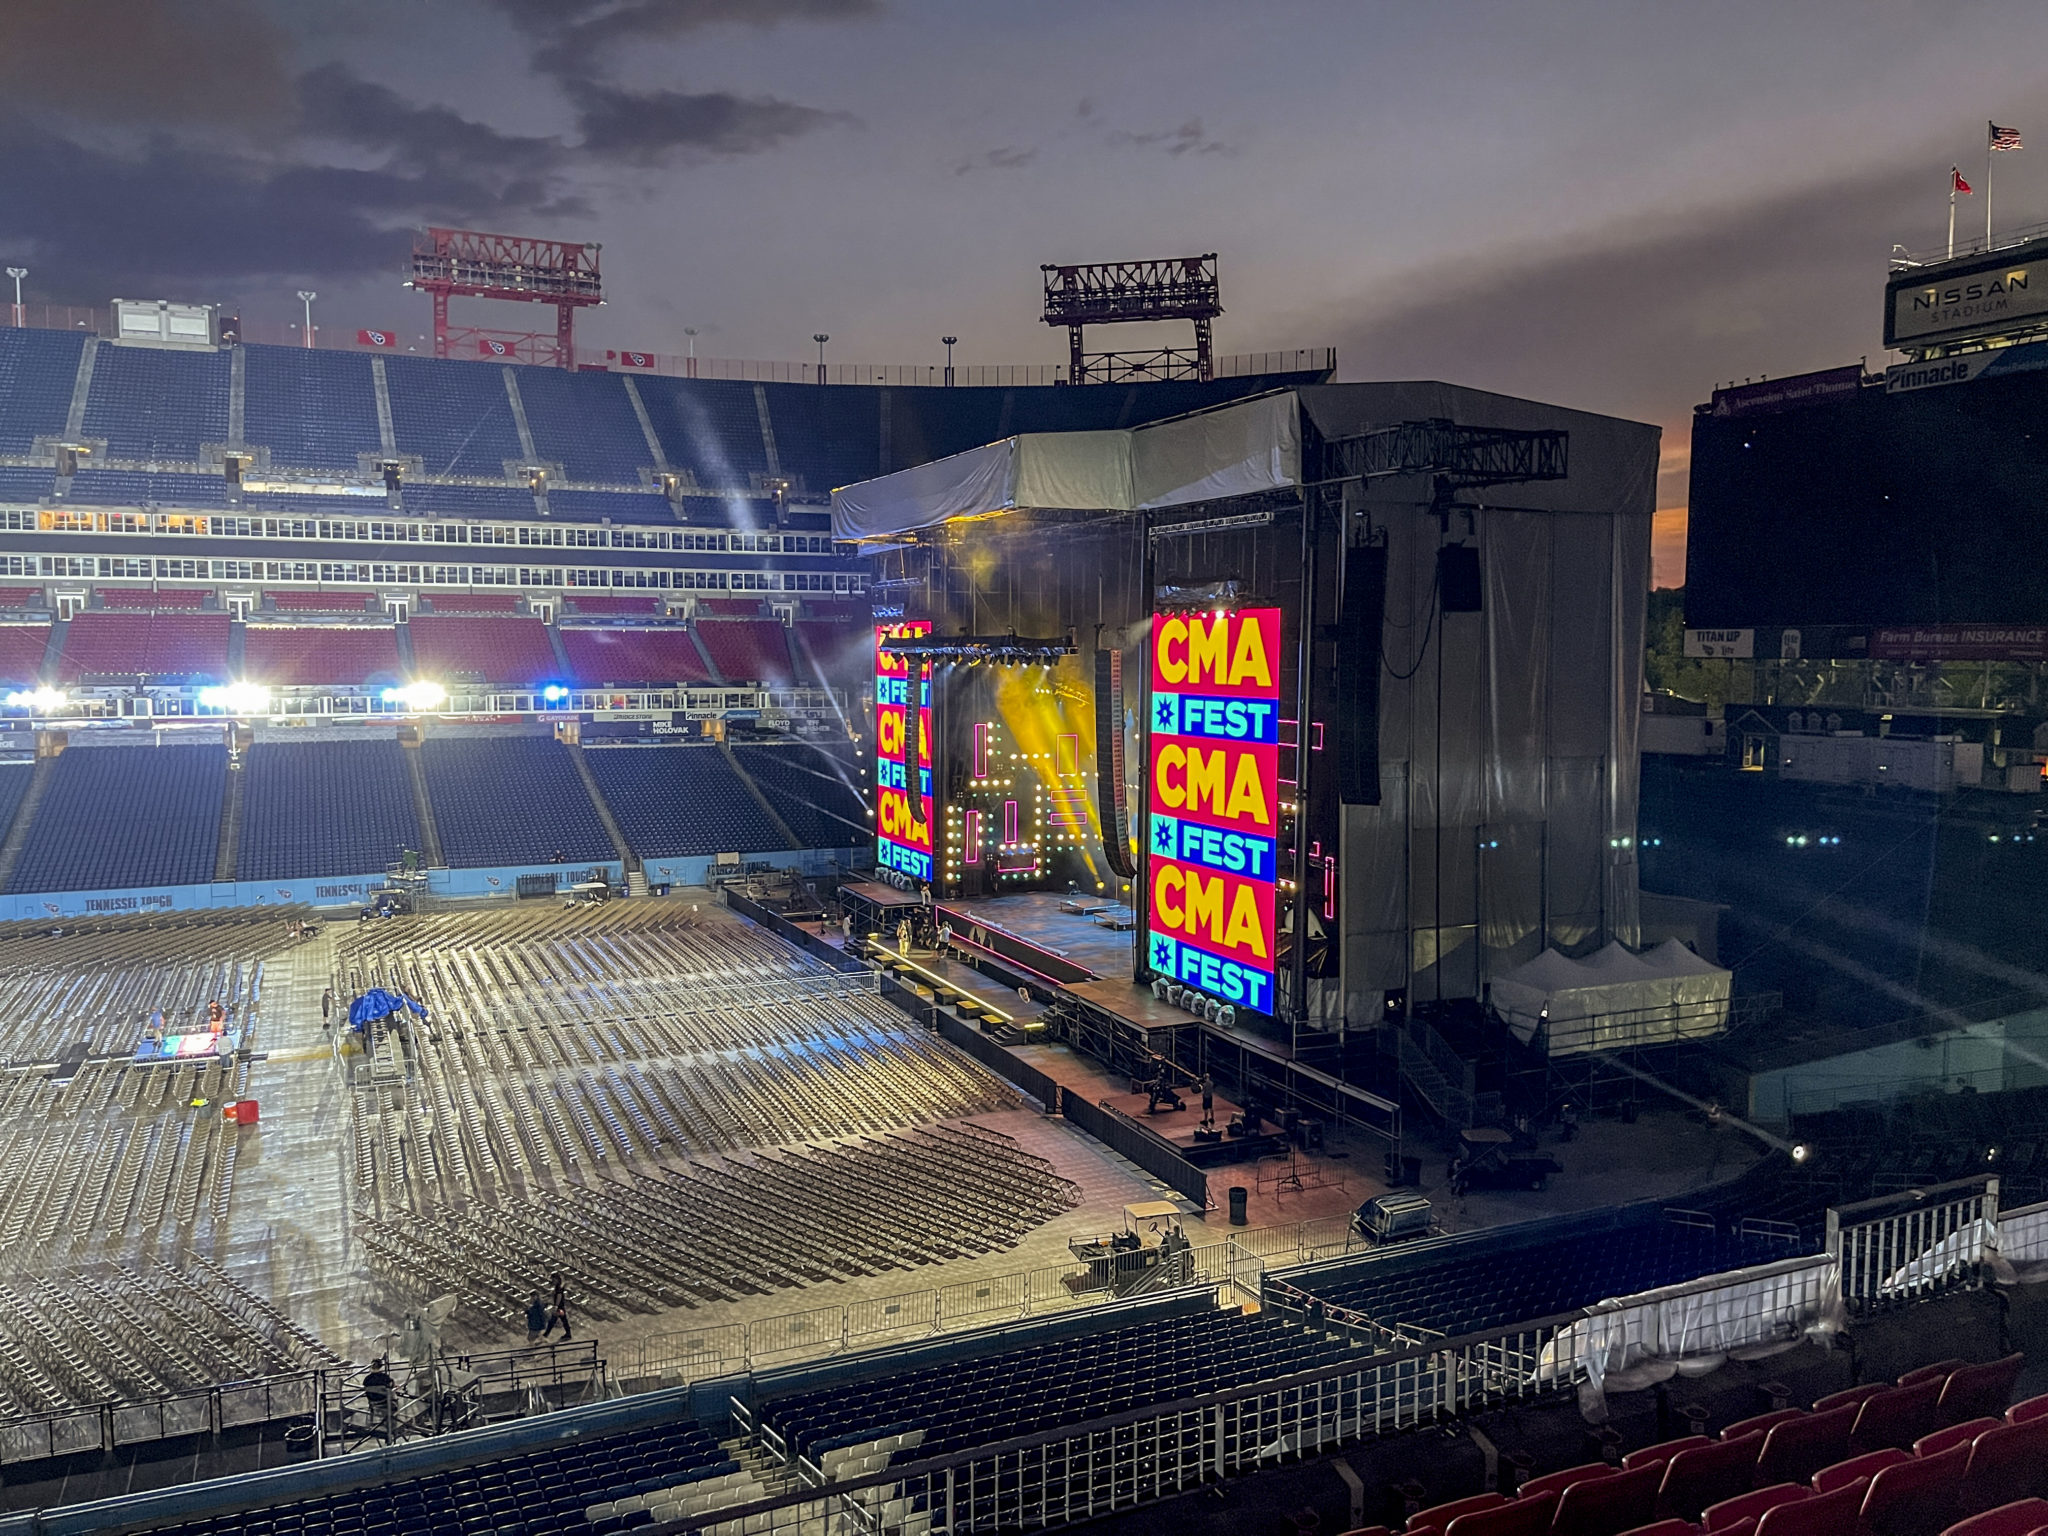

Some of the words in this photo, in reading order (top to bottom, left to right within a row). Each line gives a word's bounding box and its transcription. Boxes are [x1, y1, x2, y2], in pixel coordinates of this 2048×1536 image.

[1914, 274, 2028, 311] NISSAN
[1931, 299, 2008, 323] STADIUM
[1888, 361, 1968, 391] Pinnacle
[1157, 616, 1272, 688] CMA
[1696, 631, 1724, 642] TITAN
[1726, 631, 1740, 642] UP
[1880, 631, 1911, 643] Farm
[1913, 631, 1958, 643] Bureau
[1961, 630, 2047, 643] INSURANCE
[891, 680, 929, 705] FET
[1184, 699, 1271, 739] FEST
[892, 764, 929, 793] FET
[1156, 743, 1270, 825] CMA
[893, 845, 930, 877] FEST
[1182, 823, 1269, 876] FEST
[85, 897, 138, 912] TENNESSEE
[315, 883, 363, 898] TENNESSEE
[1154, 863, 1268, 959] CMA
[1181, 947, 1267, 1007] FEST
